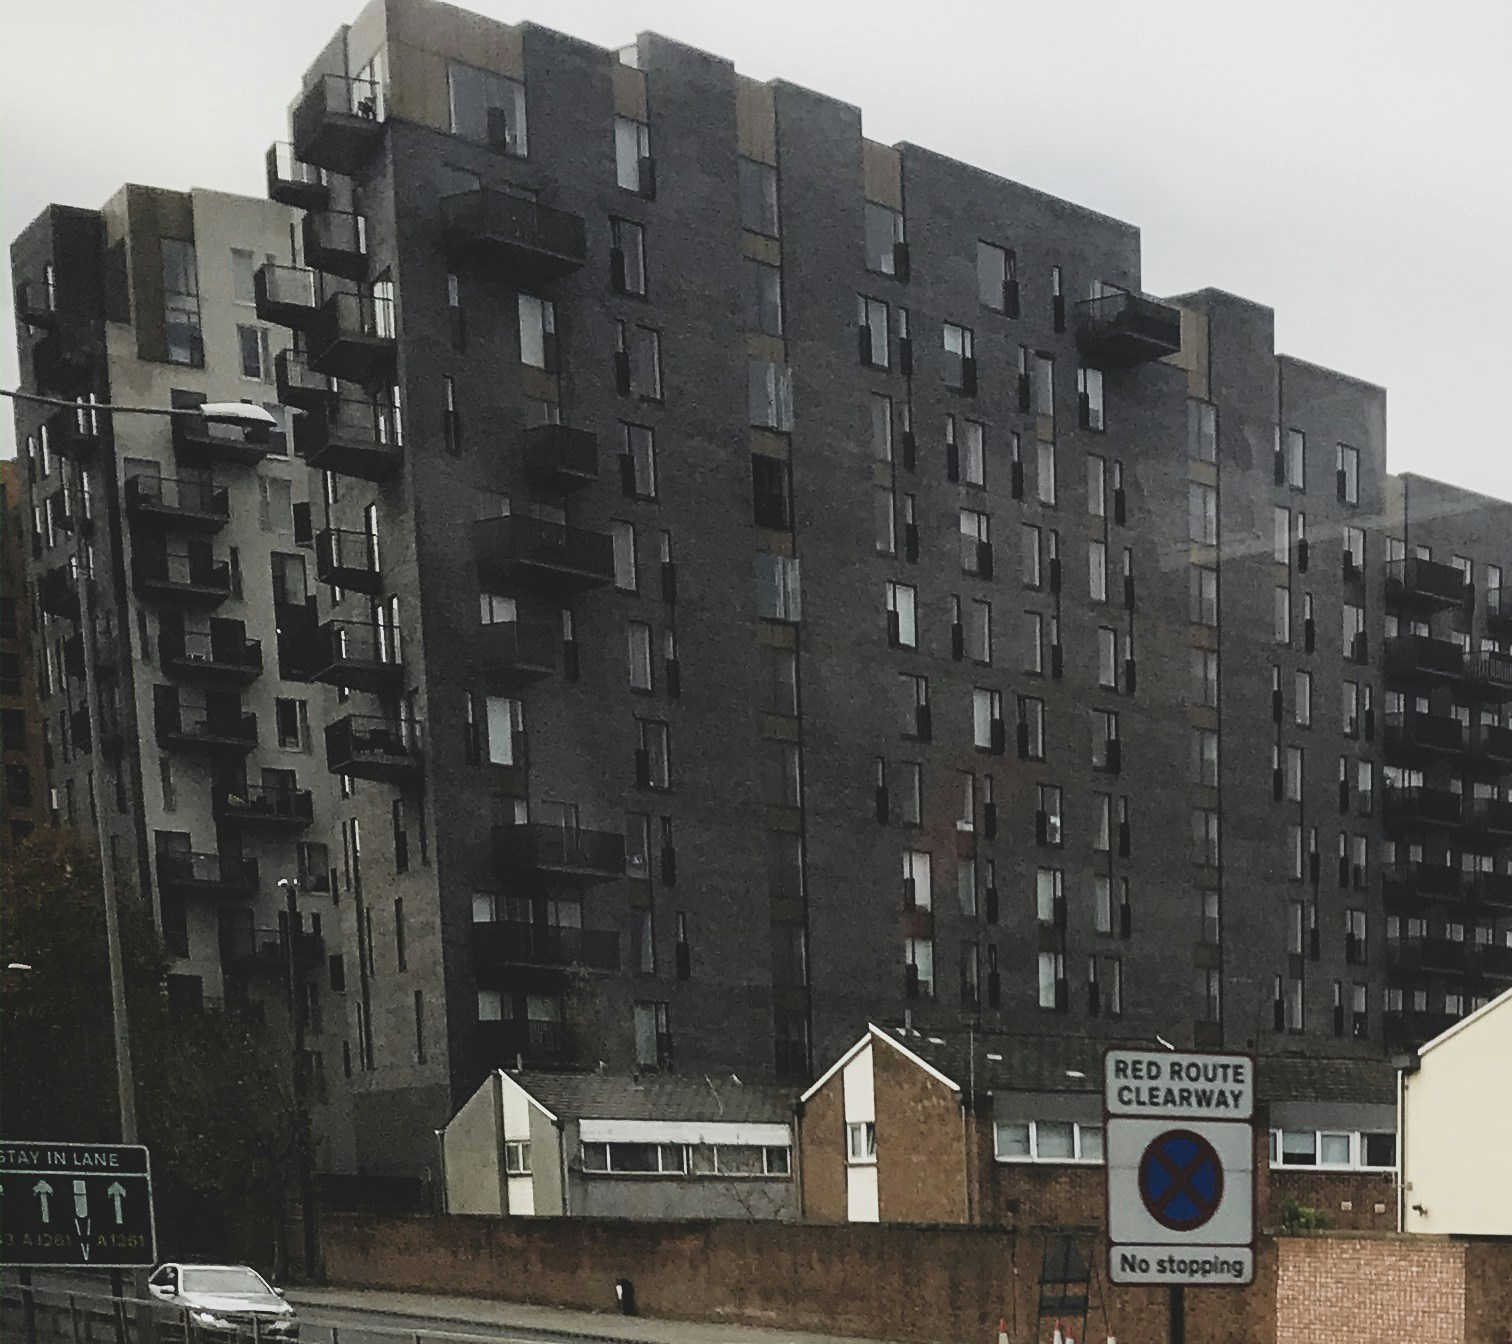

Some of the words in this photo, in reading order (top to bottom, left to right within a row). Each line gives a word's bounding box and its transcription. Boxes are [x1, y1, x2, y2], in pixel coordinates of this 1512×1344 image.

[1114, 1059, 1161, 1081] RED
[1169, 1062, 1245, 1084] ROUTE
[1117, 1085, 1244, 1109] CLEARWAY
[47, 1151, 66, 1165] IN
[73, 1152, 119, 1167] LANE
[1120, 1253, 1150, 1274] No
[1156, 1255, 1244, 1278] stopping
